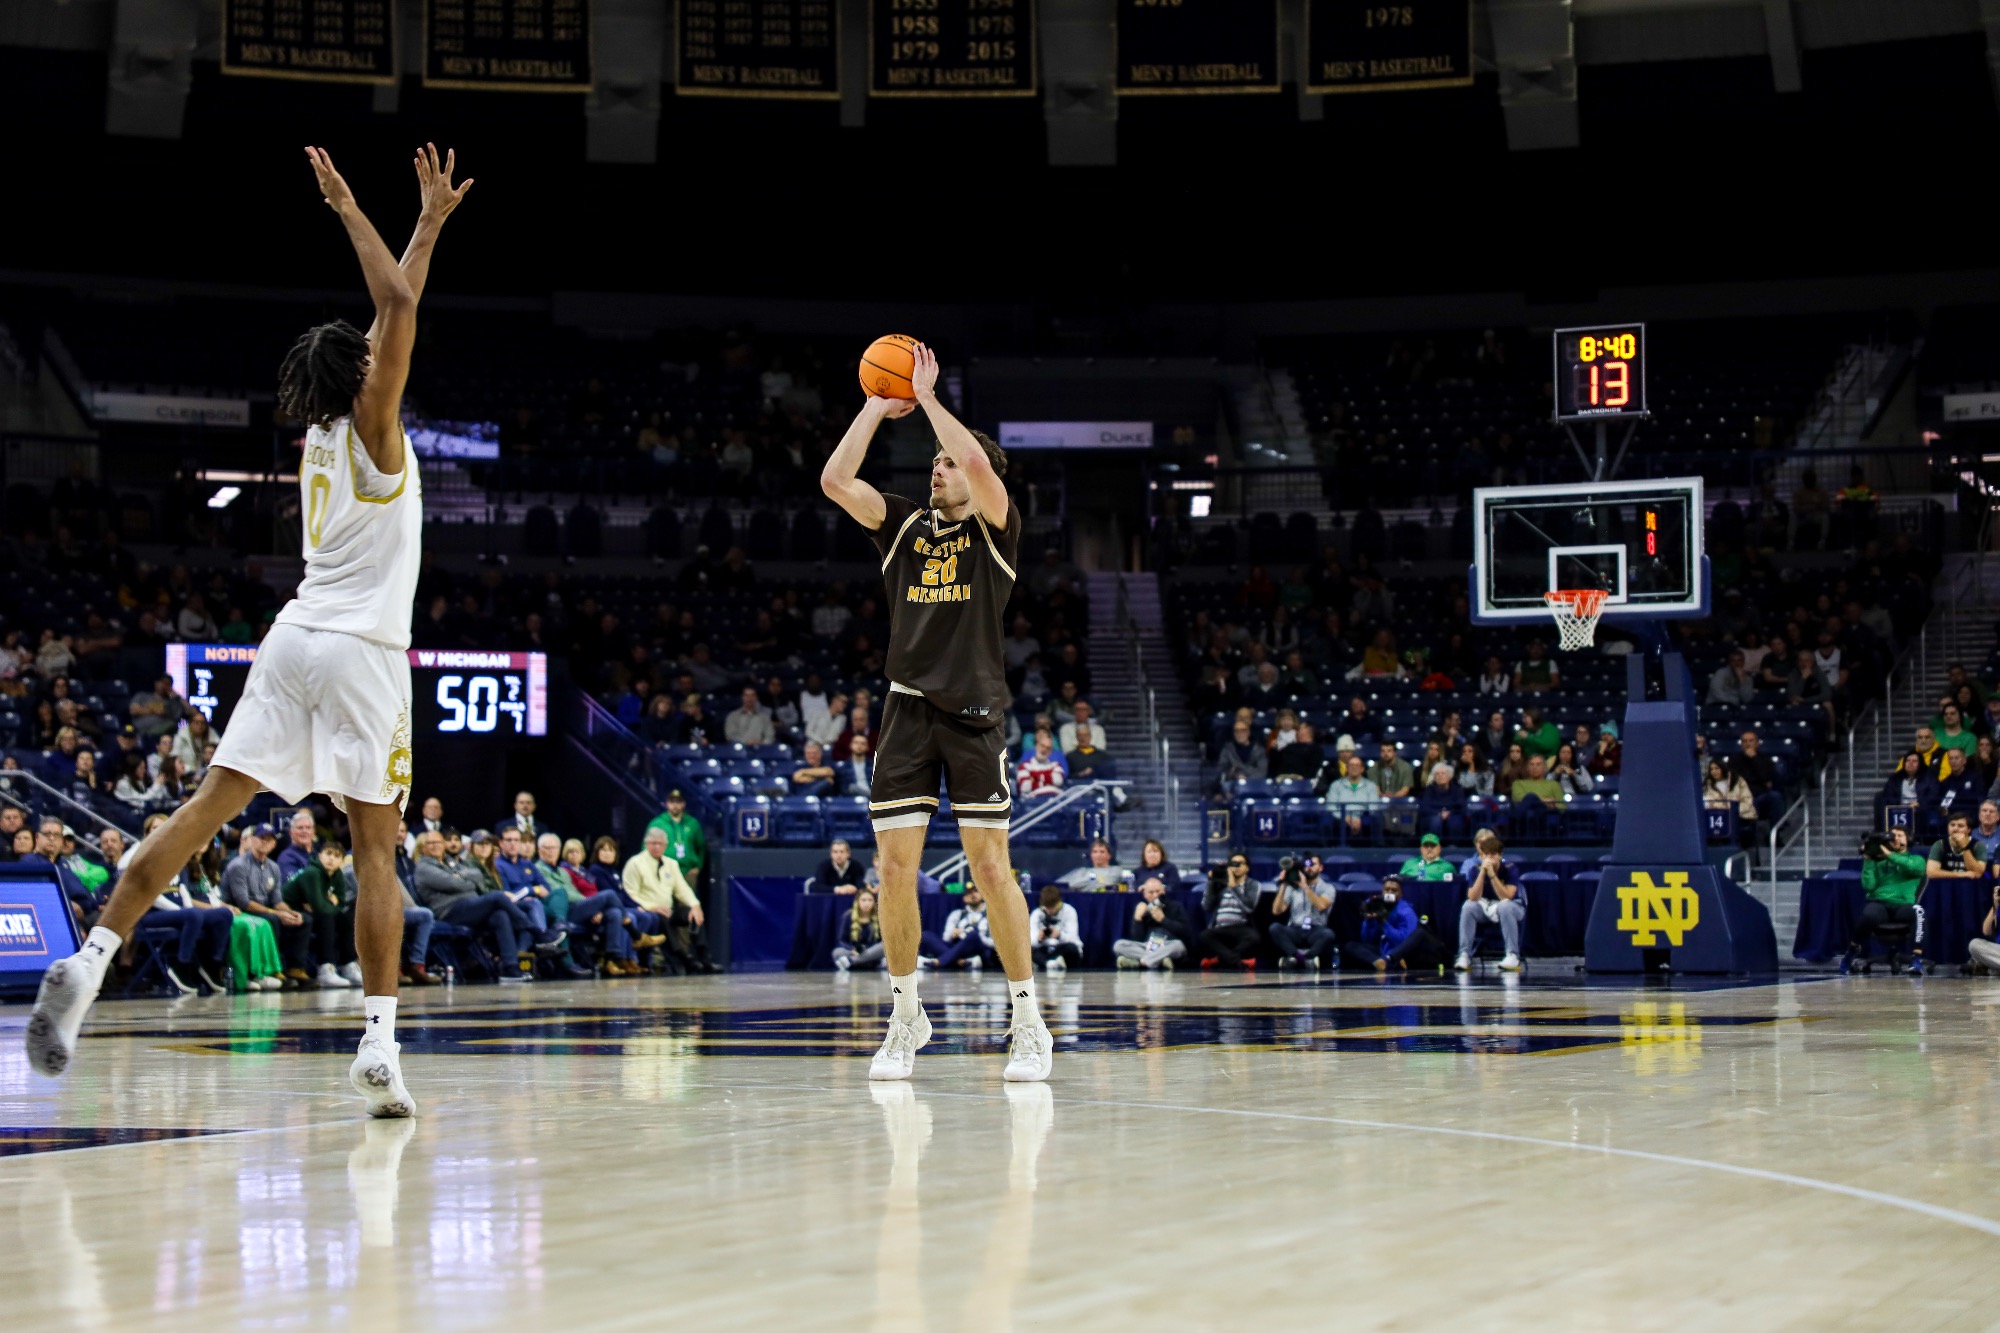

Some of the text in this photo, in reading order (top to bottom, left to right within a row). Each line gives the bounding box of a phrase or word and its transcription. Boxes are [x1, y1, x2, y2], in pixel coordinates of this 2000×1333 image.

[891, 15, 1015, 36] 1958 1978
[1365, 5, 1414, 28] 1978
[241, 43, 376, 70] MEN'S BASKETBALL
[891, 40, 1016, 61] 1979 2015
[442, 56, 576, 79] MEN'S BASKETBALL
[693, 64, 823, 85] MEN'S BASKETBALL
[888, 67, 1017, 85] MEN'S BASKETBALL
[1131, 62, 1263, 82] MEN'S BASKETBALL
[1323, 54, 1455, 80] MEN'S BASKETBALL
[1580, 334, 1635, 362] 8:40
[1590, 361, 1628, 406] 13
[308, 473, 331, 548] 0
[922, 555, 957, 585] 20
[907, 584, 970, 603] MICHIGAN
[205, 647, 258, 662] NOTRE
[418, 652, 511, 668] W MICHIGAN
[437, 675, 498, 731] 50
[746, 817, 761, 831] 13
[1259, 818, 1273, 831] 14
[1709, 815, 1724, 828] 14
[1893, 814, 1907, 826] 15
[1617, 871, 1699, 946] ND
